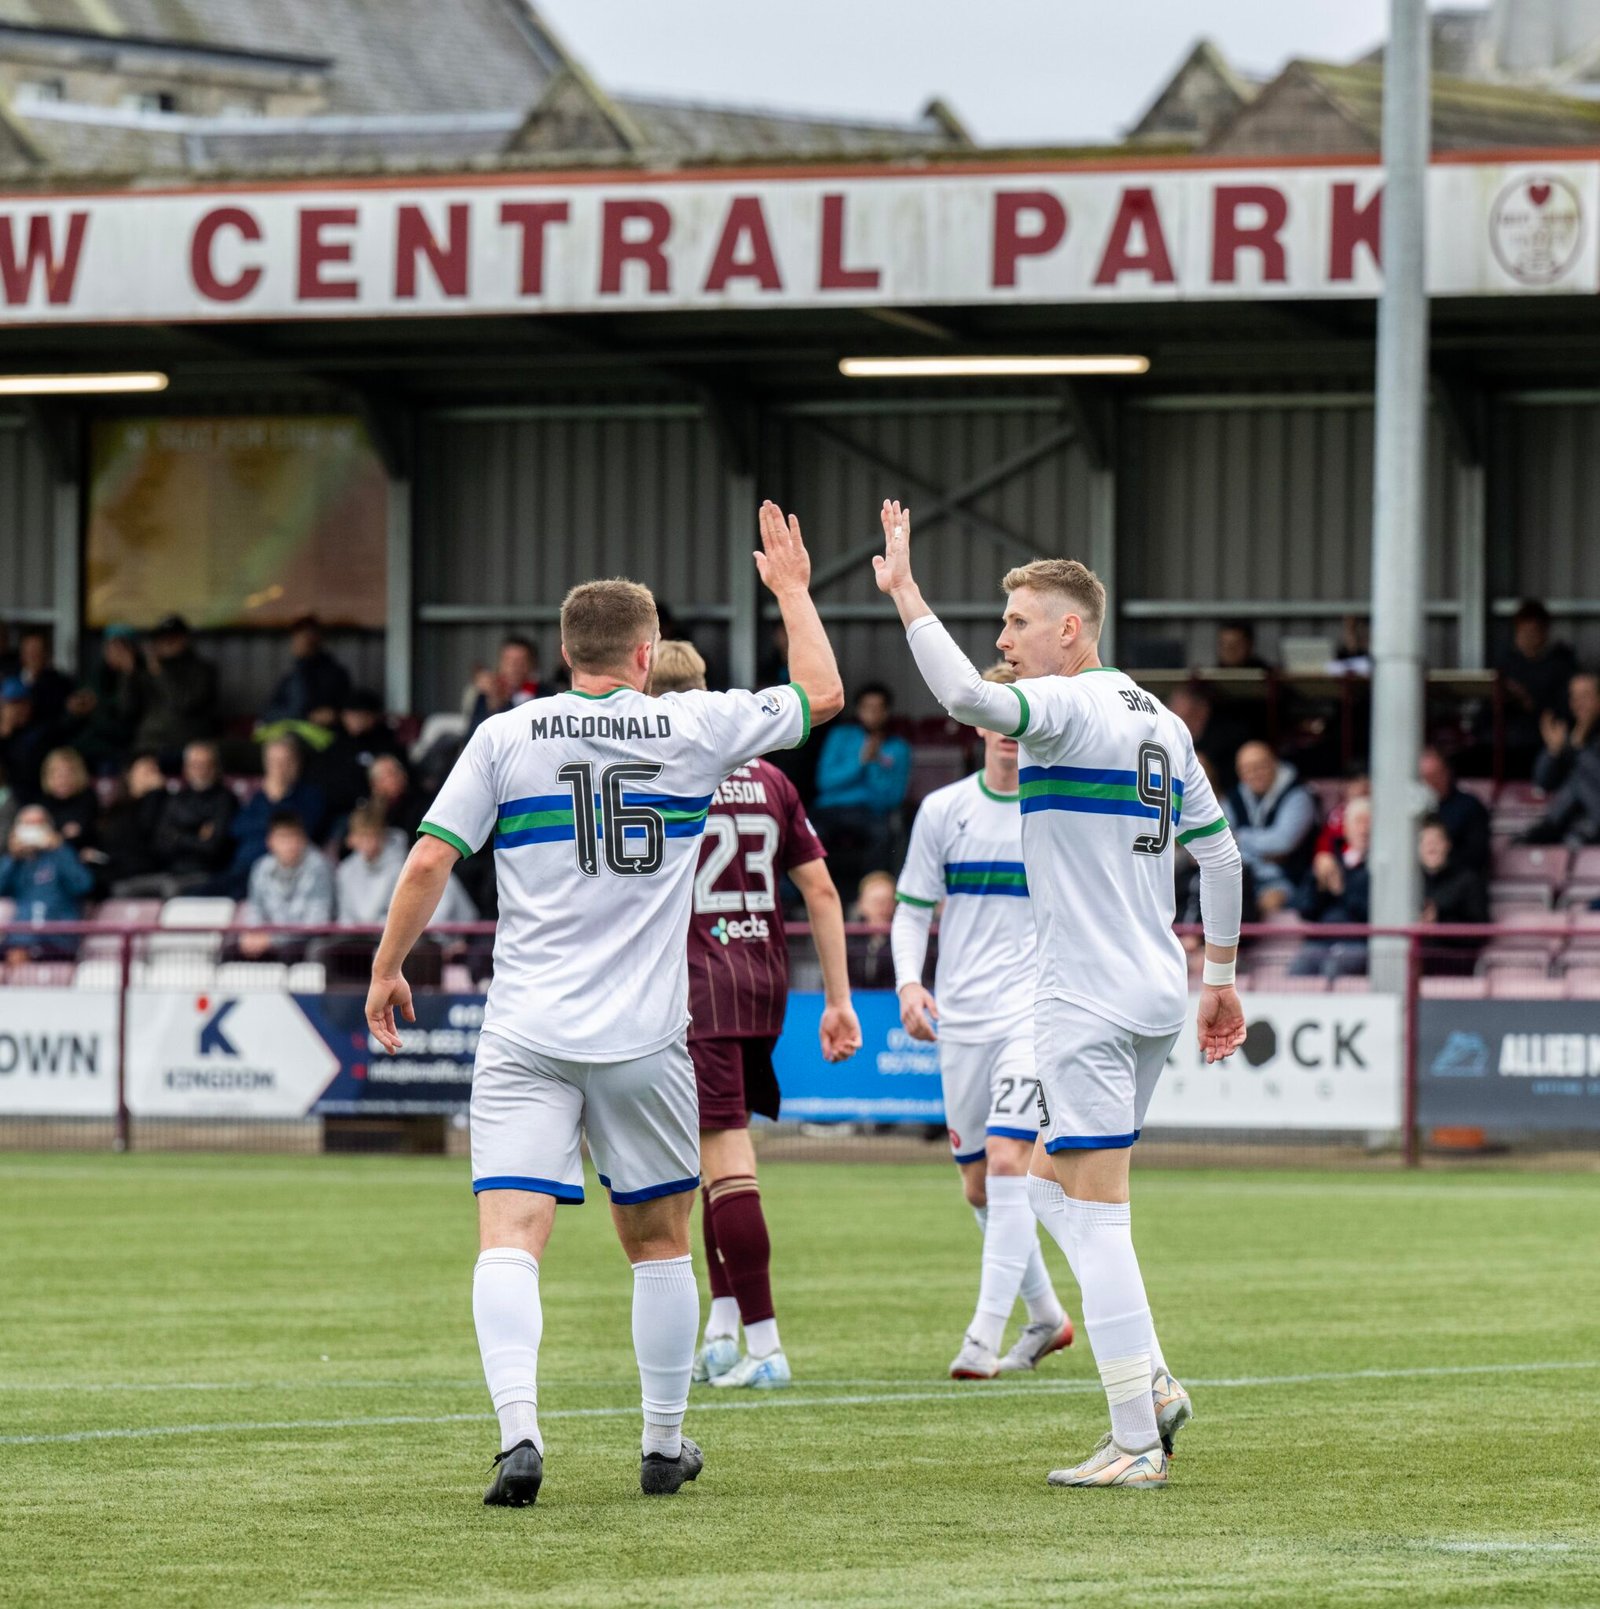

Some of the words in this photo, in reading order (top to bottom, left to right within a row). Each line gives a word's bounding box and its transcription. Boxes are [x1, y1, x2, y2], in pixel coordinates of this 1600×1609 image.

[0, 212, 90, 305] W
[189, 195, 884, 304] CENTRAL
[990, 182, 1384, 289] PARK
[531, 714, 672, 741] MACDONALD
[555, 760, 666, 878] 16
[1131, 738, 1173, 858] 9
[693, 813, 780, 914] 23
[726, 913, 770, 939] ects
[995, 1078, 1038, 1115] 27
